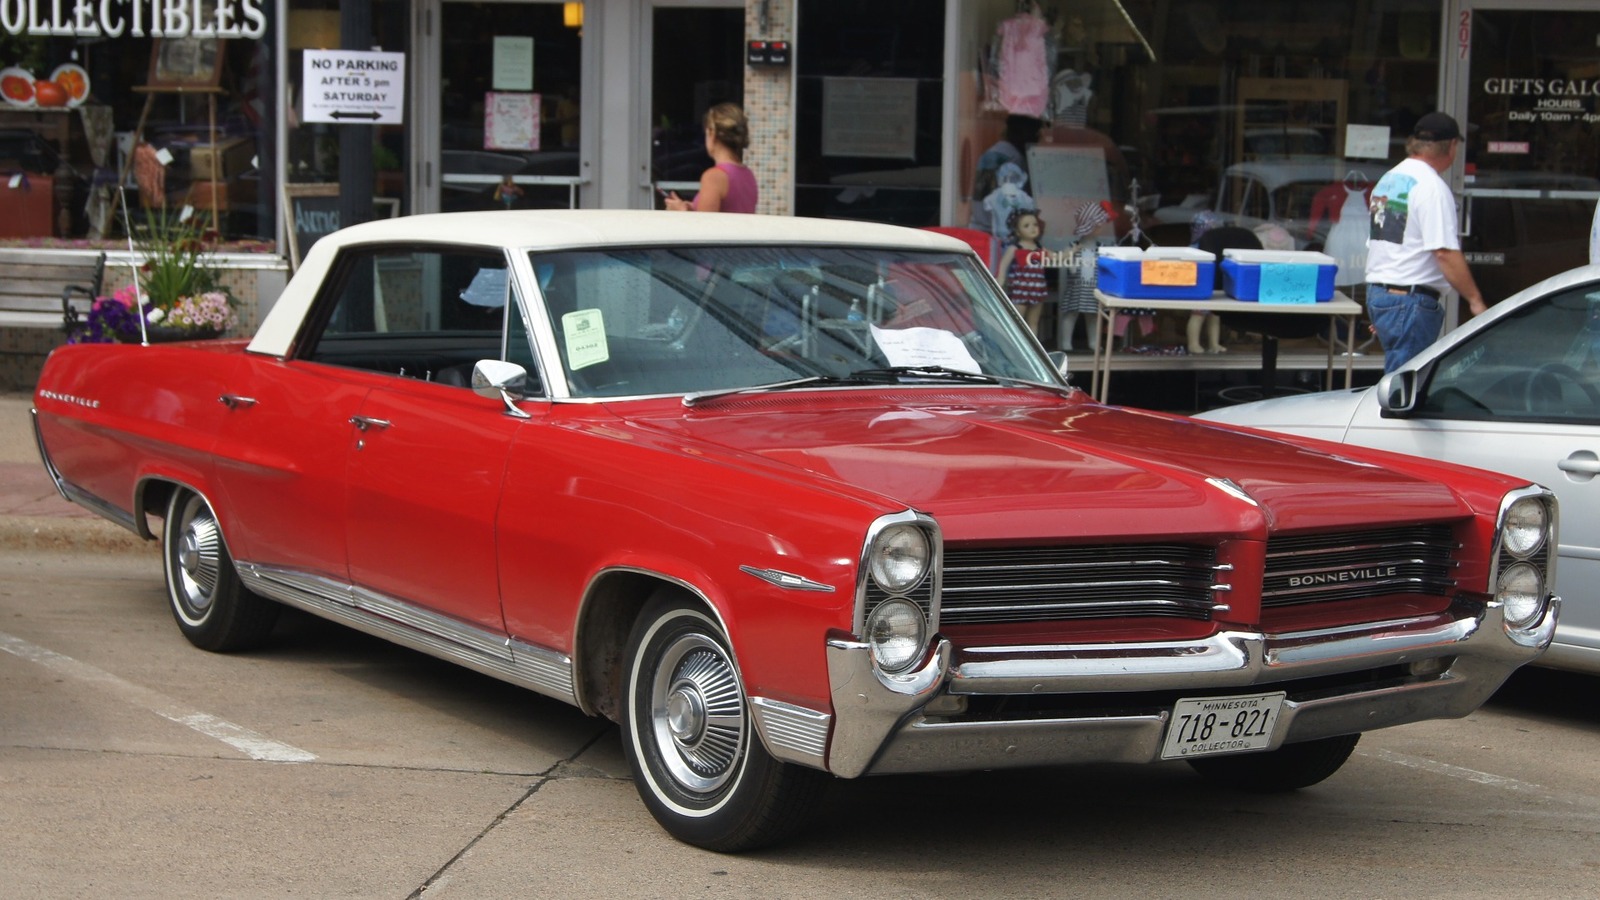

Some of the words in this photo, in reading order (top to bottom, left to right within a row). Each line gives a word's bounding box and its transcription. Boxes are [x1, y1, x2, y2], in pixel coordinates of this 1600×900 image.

[312, 59, 332, 69] NO
[336, 59, 398, 71] PARKING
[321, 76, 360, 86] AFTER
[363, 77, 371, 86] 5
[374, 79, 390, 88] pm
[1484, 78, 1544, 95] GIFTS
[323, 92, 387, 102] SATURDAY
[1537, 99, 1582, 108] HOURS
[1509, 111, 1537, 122] Daily
[1541, 112, 1571, 121] 10am
[40, 390, 100, 408] BONNEVILLE
[1290, 567, 1396, 586] BONNEVILLE
[1203, 700, 1258, 711] MINNESOTA
[1177, 708, 1271, 743] 718-821
[1191, 740, 1243, 752] COLLECTOR
